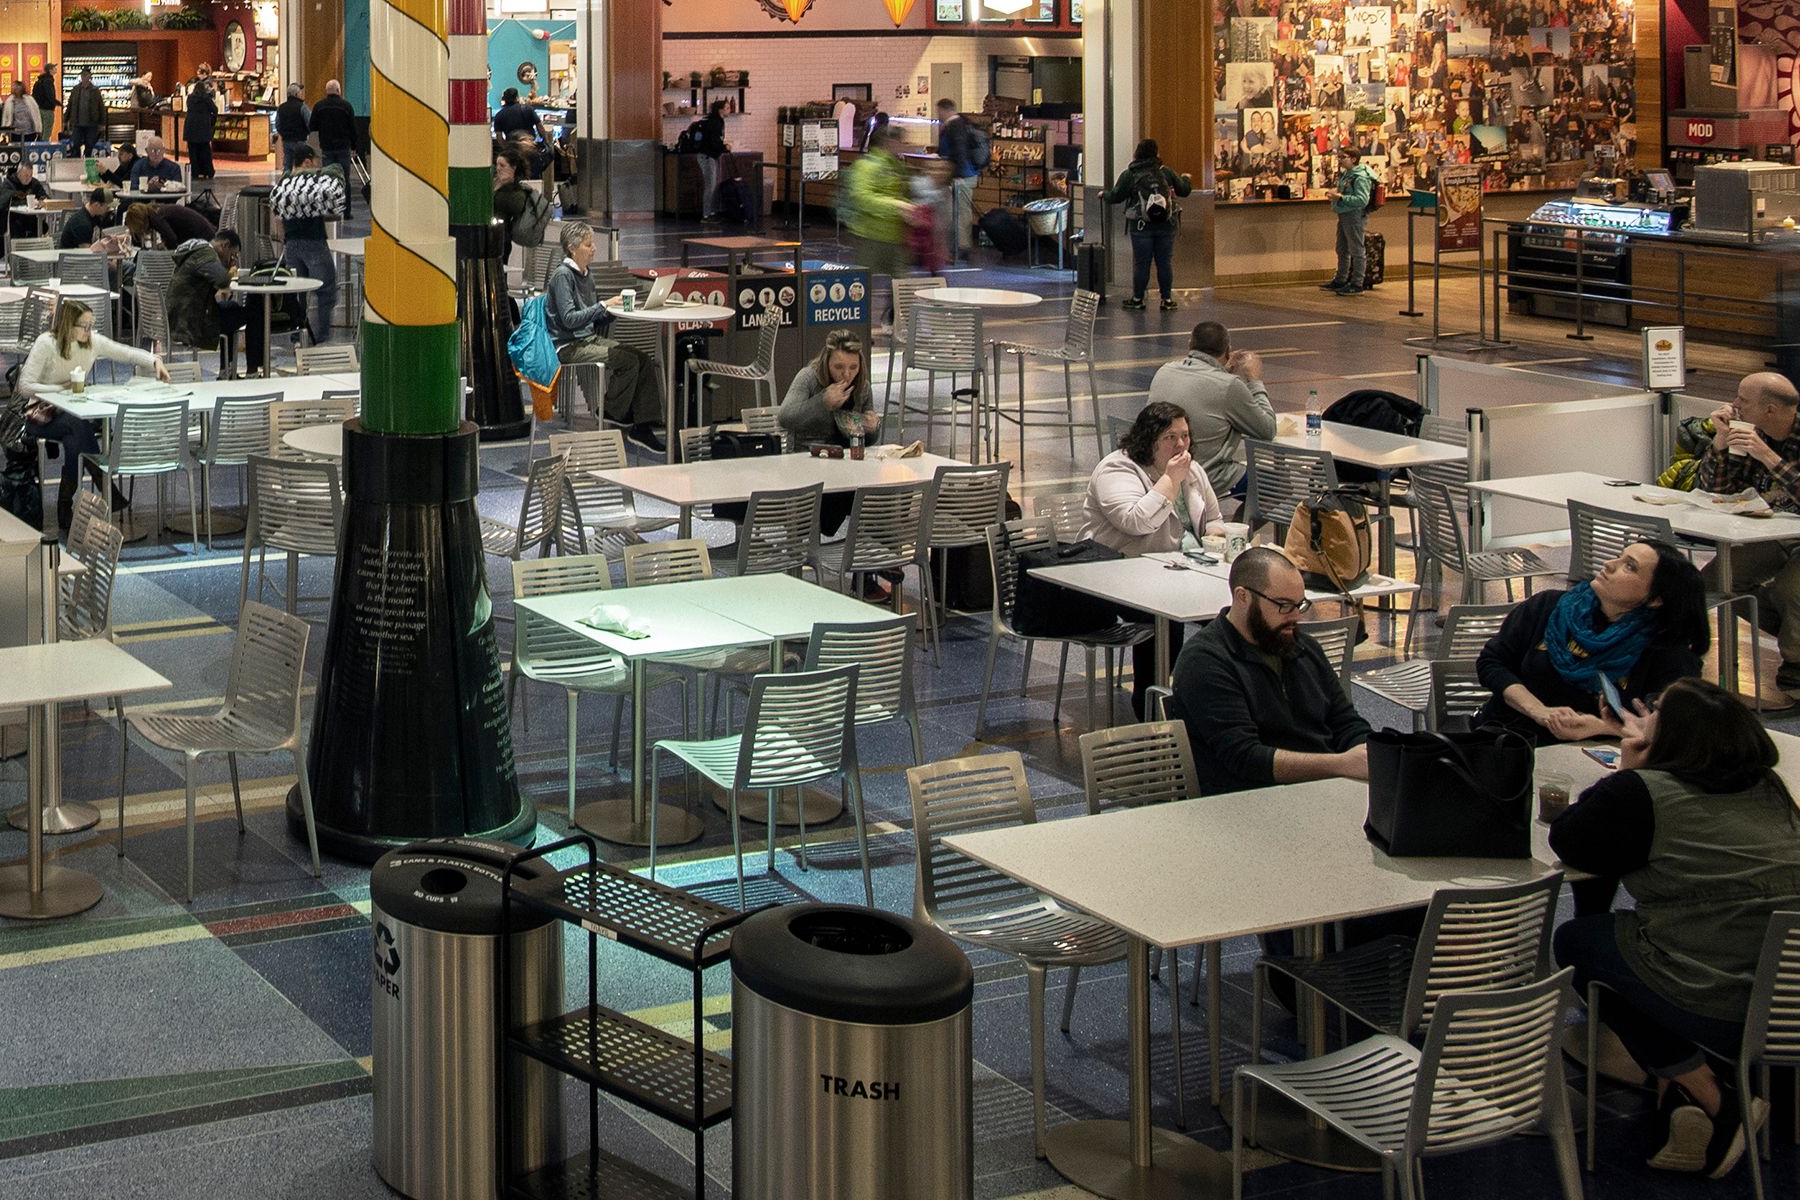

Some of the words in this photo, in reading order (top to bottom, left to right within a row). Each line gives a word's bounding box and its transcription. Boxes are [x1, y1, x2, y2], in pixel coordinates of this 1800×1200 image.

[1688, 123, 1714, 137] MOD
[814, 306, 861, 322] RECYCLE
[820, 1073, 900, 1101] TRASH
